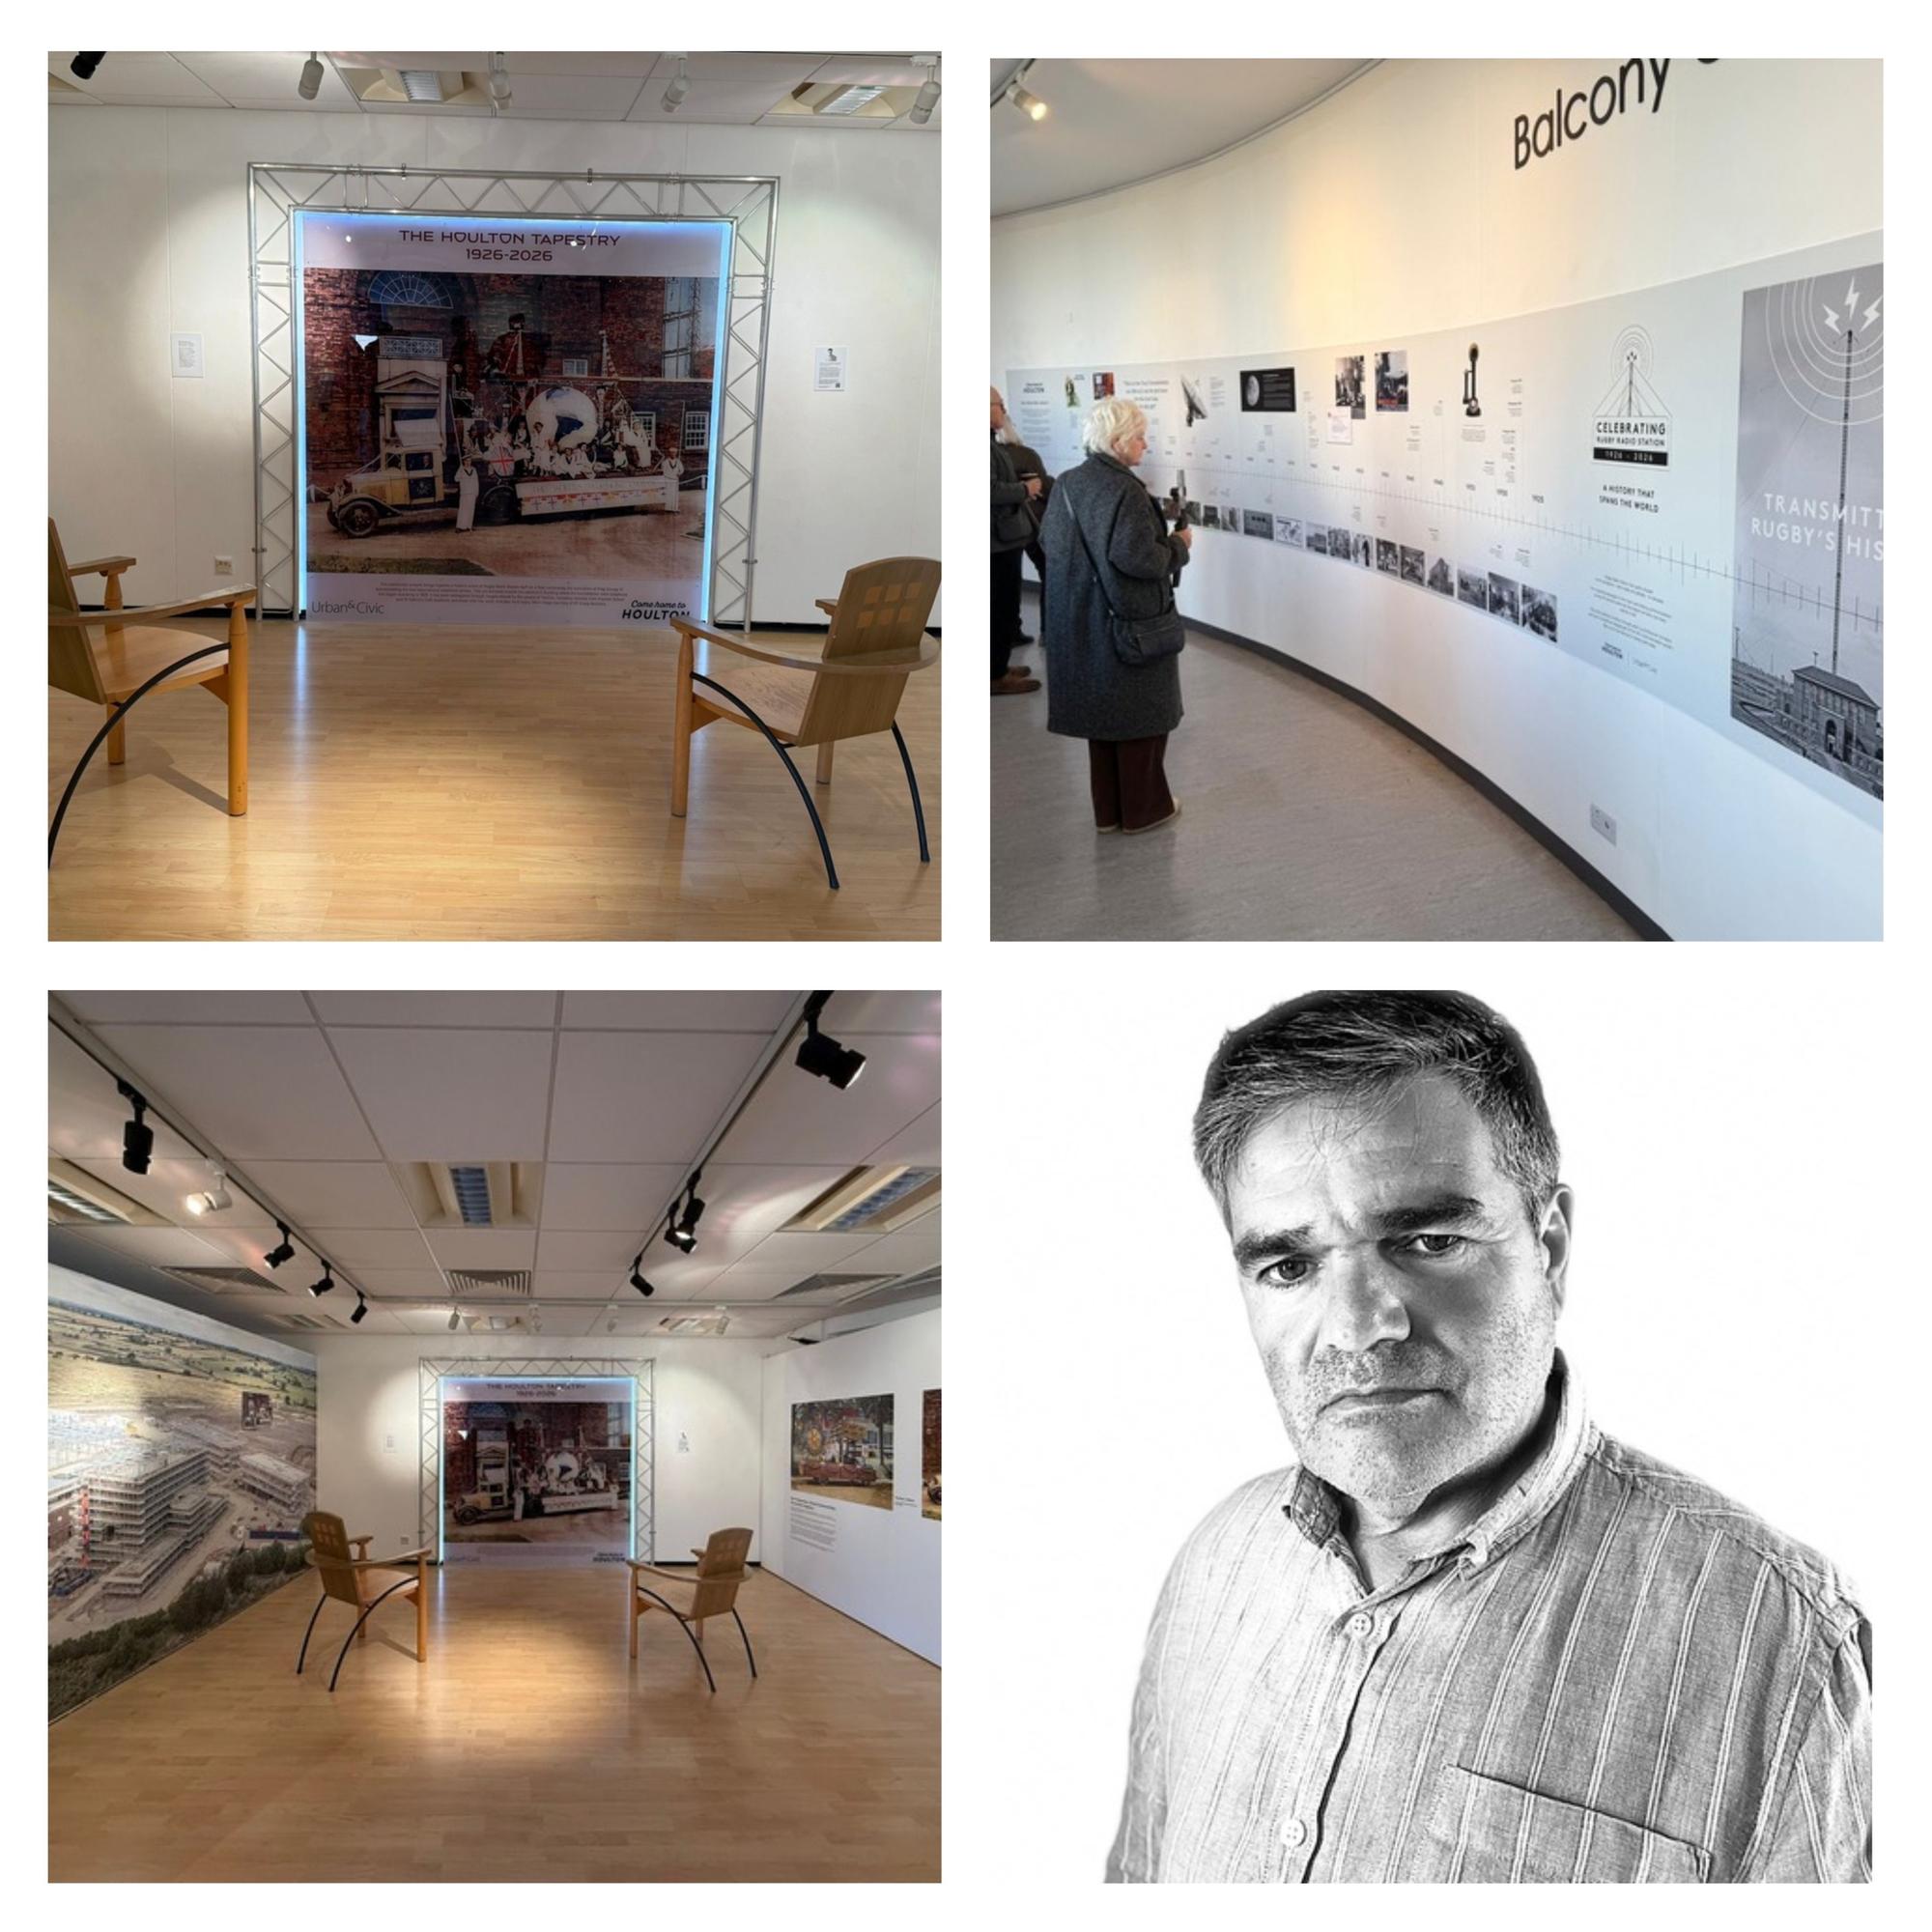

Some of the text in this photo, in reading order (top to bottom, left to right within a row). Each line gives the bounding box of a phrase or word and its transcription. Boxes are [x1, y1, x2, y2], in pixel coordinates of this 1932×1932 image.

[1515, 58, 1670, 170] Balcony
[399, 230, 620, 246] THE HOULTON TAPESTRY
[466, 248, 554, 262] 1926-2026
[1597, 421, 1665, 435] CELEBRATING
[1616, 437, 1635, 445] RADIO
[1637, 438, 1665, 446] STATION
[1637, 488, 1655, 498] THAT
[1634, 501, 1659, 513] WORLD
[1764, 493, 1883, 530] TRANSMITT
[1751, 517, 1883, 561] RUGBY'S HIS
[631, 600, 654, 609] Come
